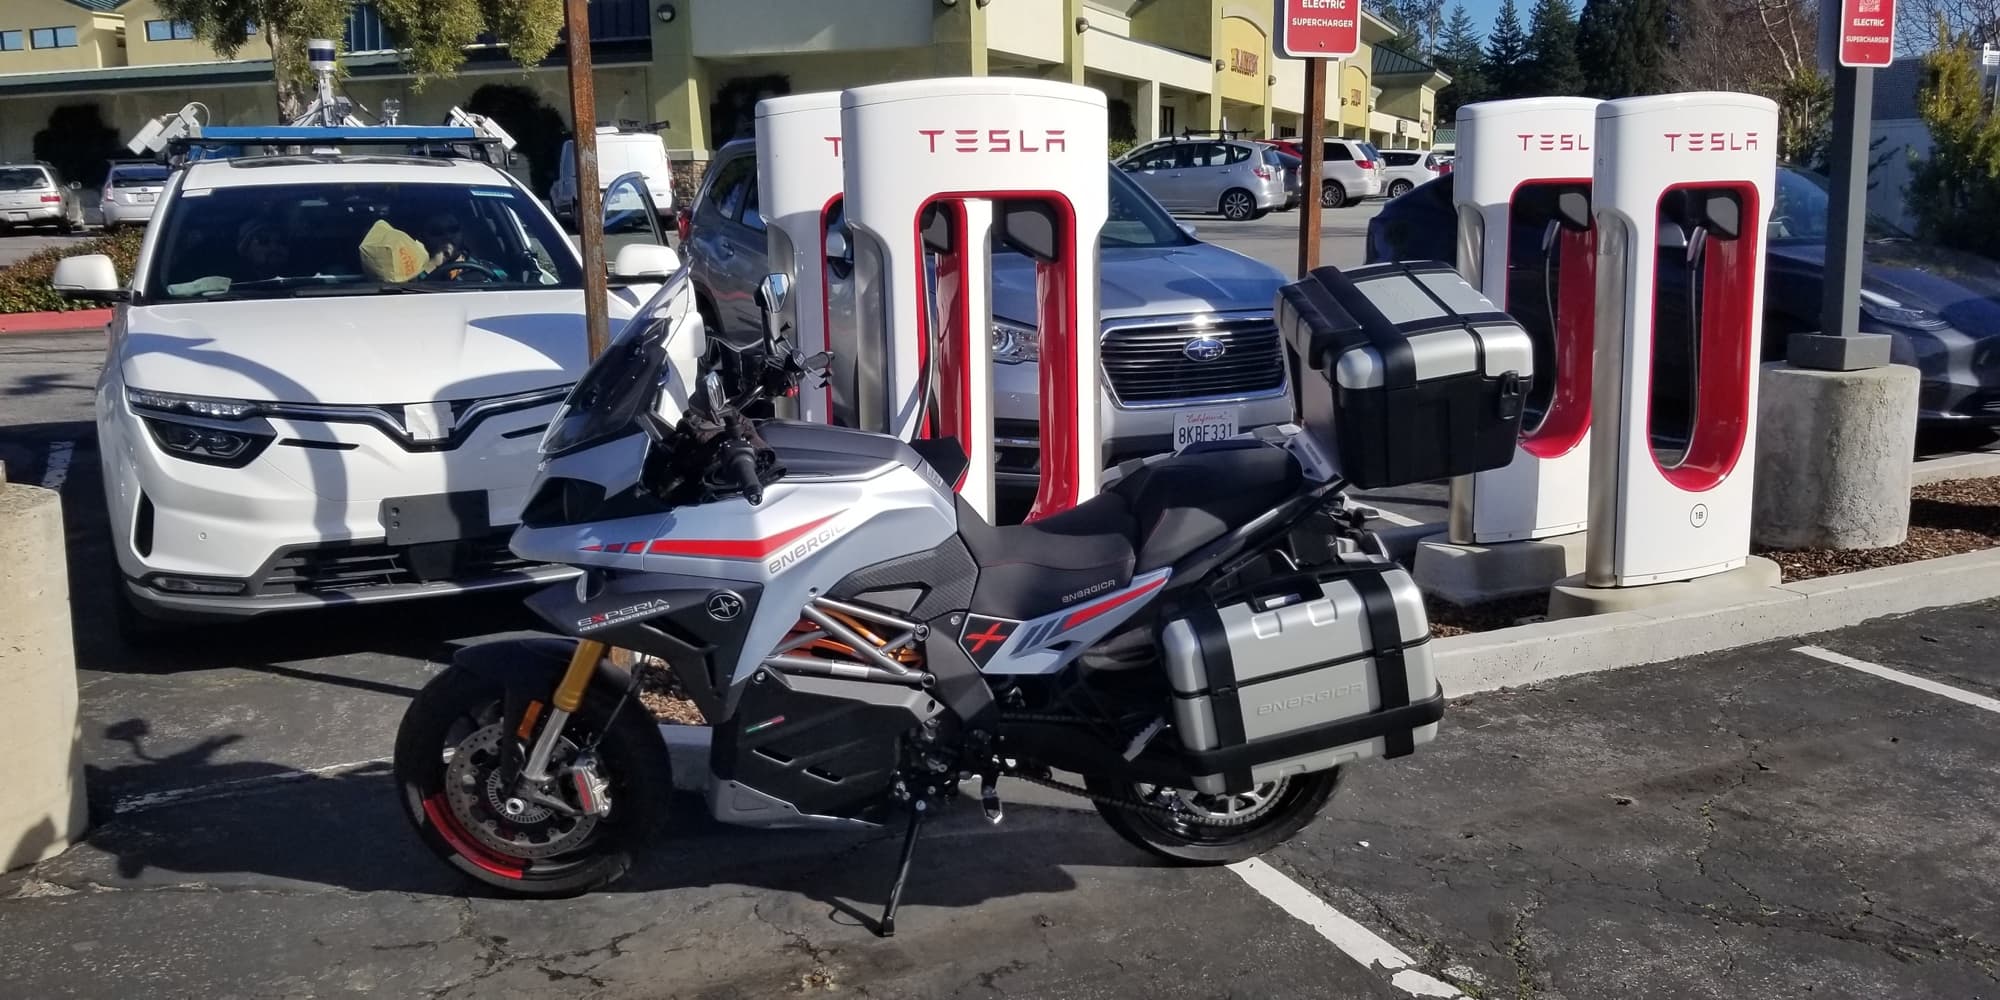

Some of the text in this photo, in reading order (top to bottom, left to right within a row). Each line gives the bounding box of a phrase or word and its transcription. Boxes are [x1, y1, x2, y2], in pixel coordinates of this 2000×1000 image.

[1302, 0, 1346, 9] ELECTRIC
[1292, 17, 1353, 28] SUPERCHARGER
[1853, 18, 1885, 27] ELECTRIC
[1846, 35, 1890, 44] SUPERCHARGER
[918, 129, 1066, 153] TESLA
[1517, 134, 1590, 151] TESL
[1663, 132, 1758, 152] TESLA
[768, 525, 846, 575] ENERGI
[1061, 579, 1116, 603] ENERGICA
[577, 598, 669, 627] EXPERIA
